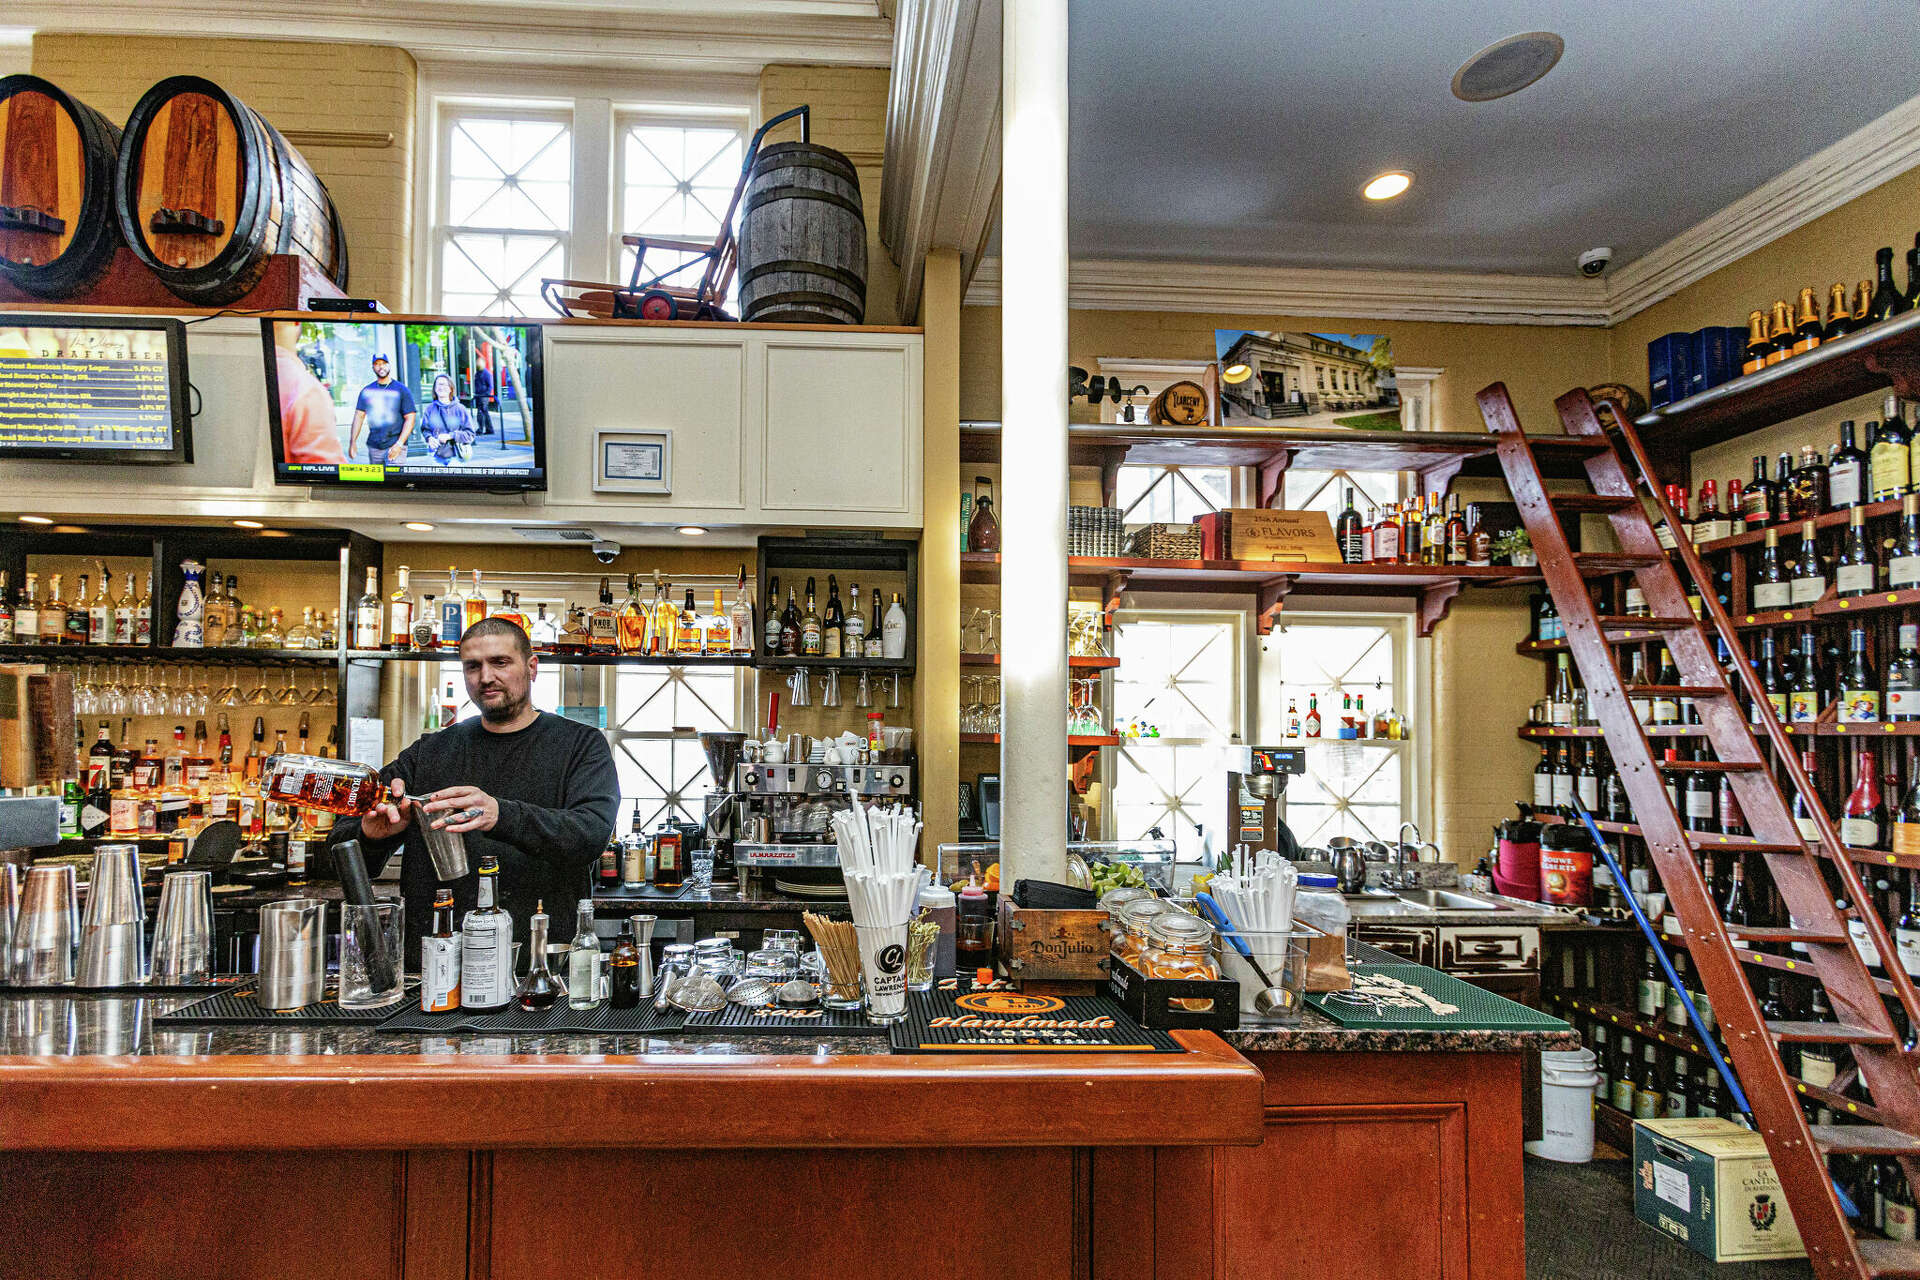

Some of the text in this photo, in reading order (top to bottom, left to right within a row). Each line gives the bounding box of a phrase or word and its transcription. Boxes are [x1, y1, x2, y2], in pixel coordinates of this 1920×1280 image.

[42, 350, 104, 358] DRAFT
[1262, 527, 1316, 537] FLAVORS
[445, 606, 458, 621] P
[593, 619, 611, 631] KNOB
[347, 777, 361, 807] BUMBU
[928, 1014, 1116, 1029] Handmade
[979, 1029, 1078, 1037] VODKA
[1742, 1177, 1778, 1186] CANTIN
